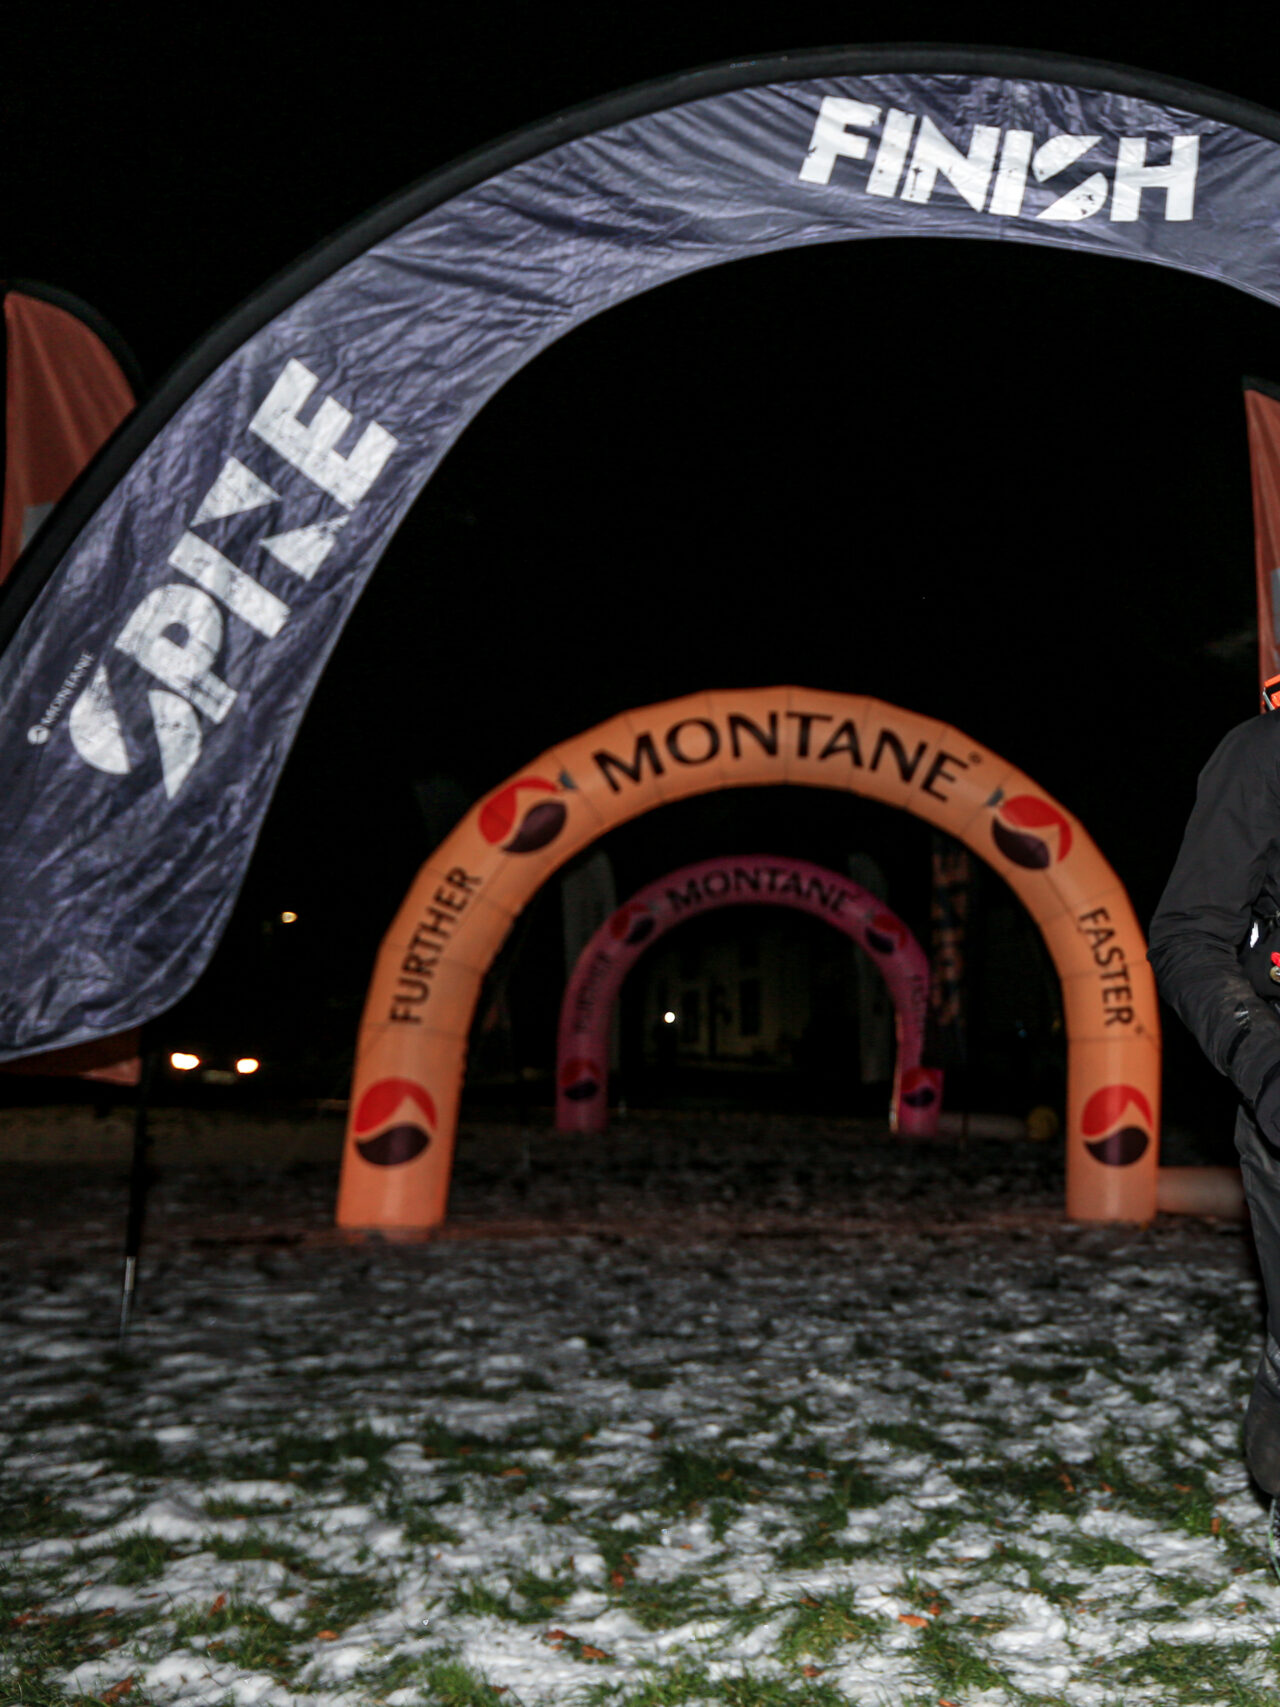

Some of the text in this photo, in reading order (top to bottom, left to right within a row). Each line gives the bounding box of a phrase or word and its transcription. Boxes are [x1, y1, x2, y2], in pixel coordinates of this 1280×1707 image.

[798, 95, 1200, 222] FINISH
[69, 358, 399, 799] SPINE
[40, 650, 94, 727] MONTANE
[592, 711, 968, 802] MONTANE
[389, 867, 483, 1024] FURTHER
[666, 867, 861, 917] MONTANE
[1079, 907, 1134, 1027] FASTER
